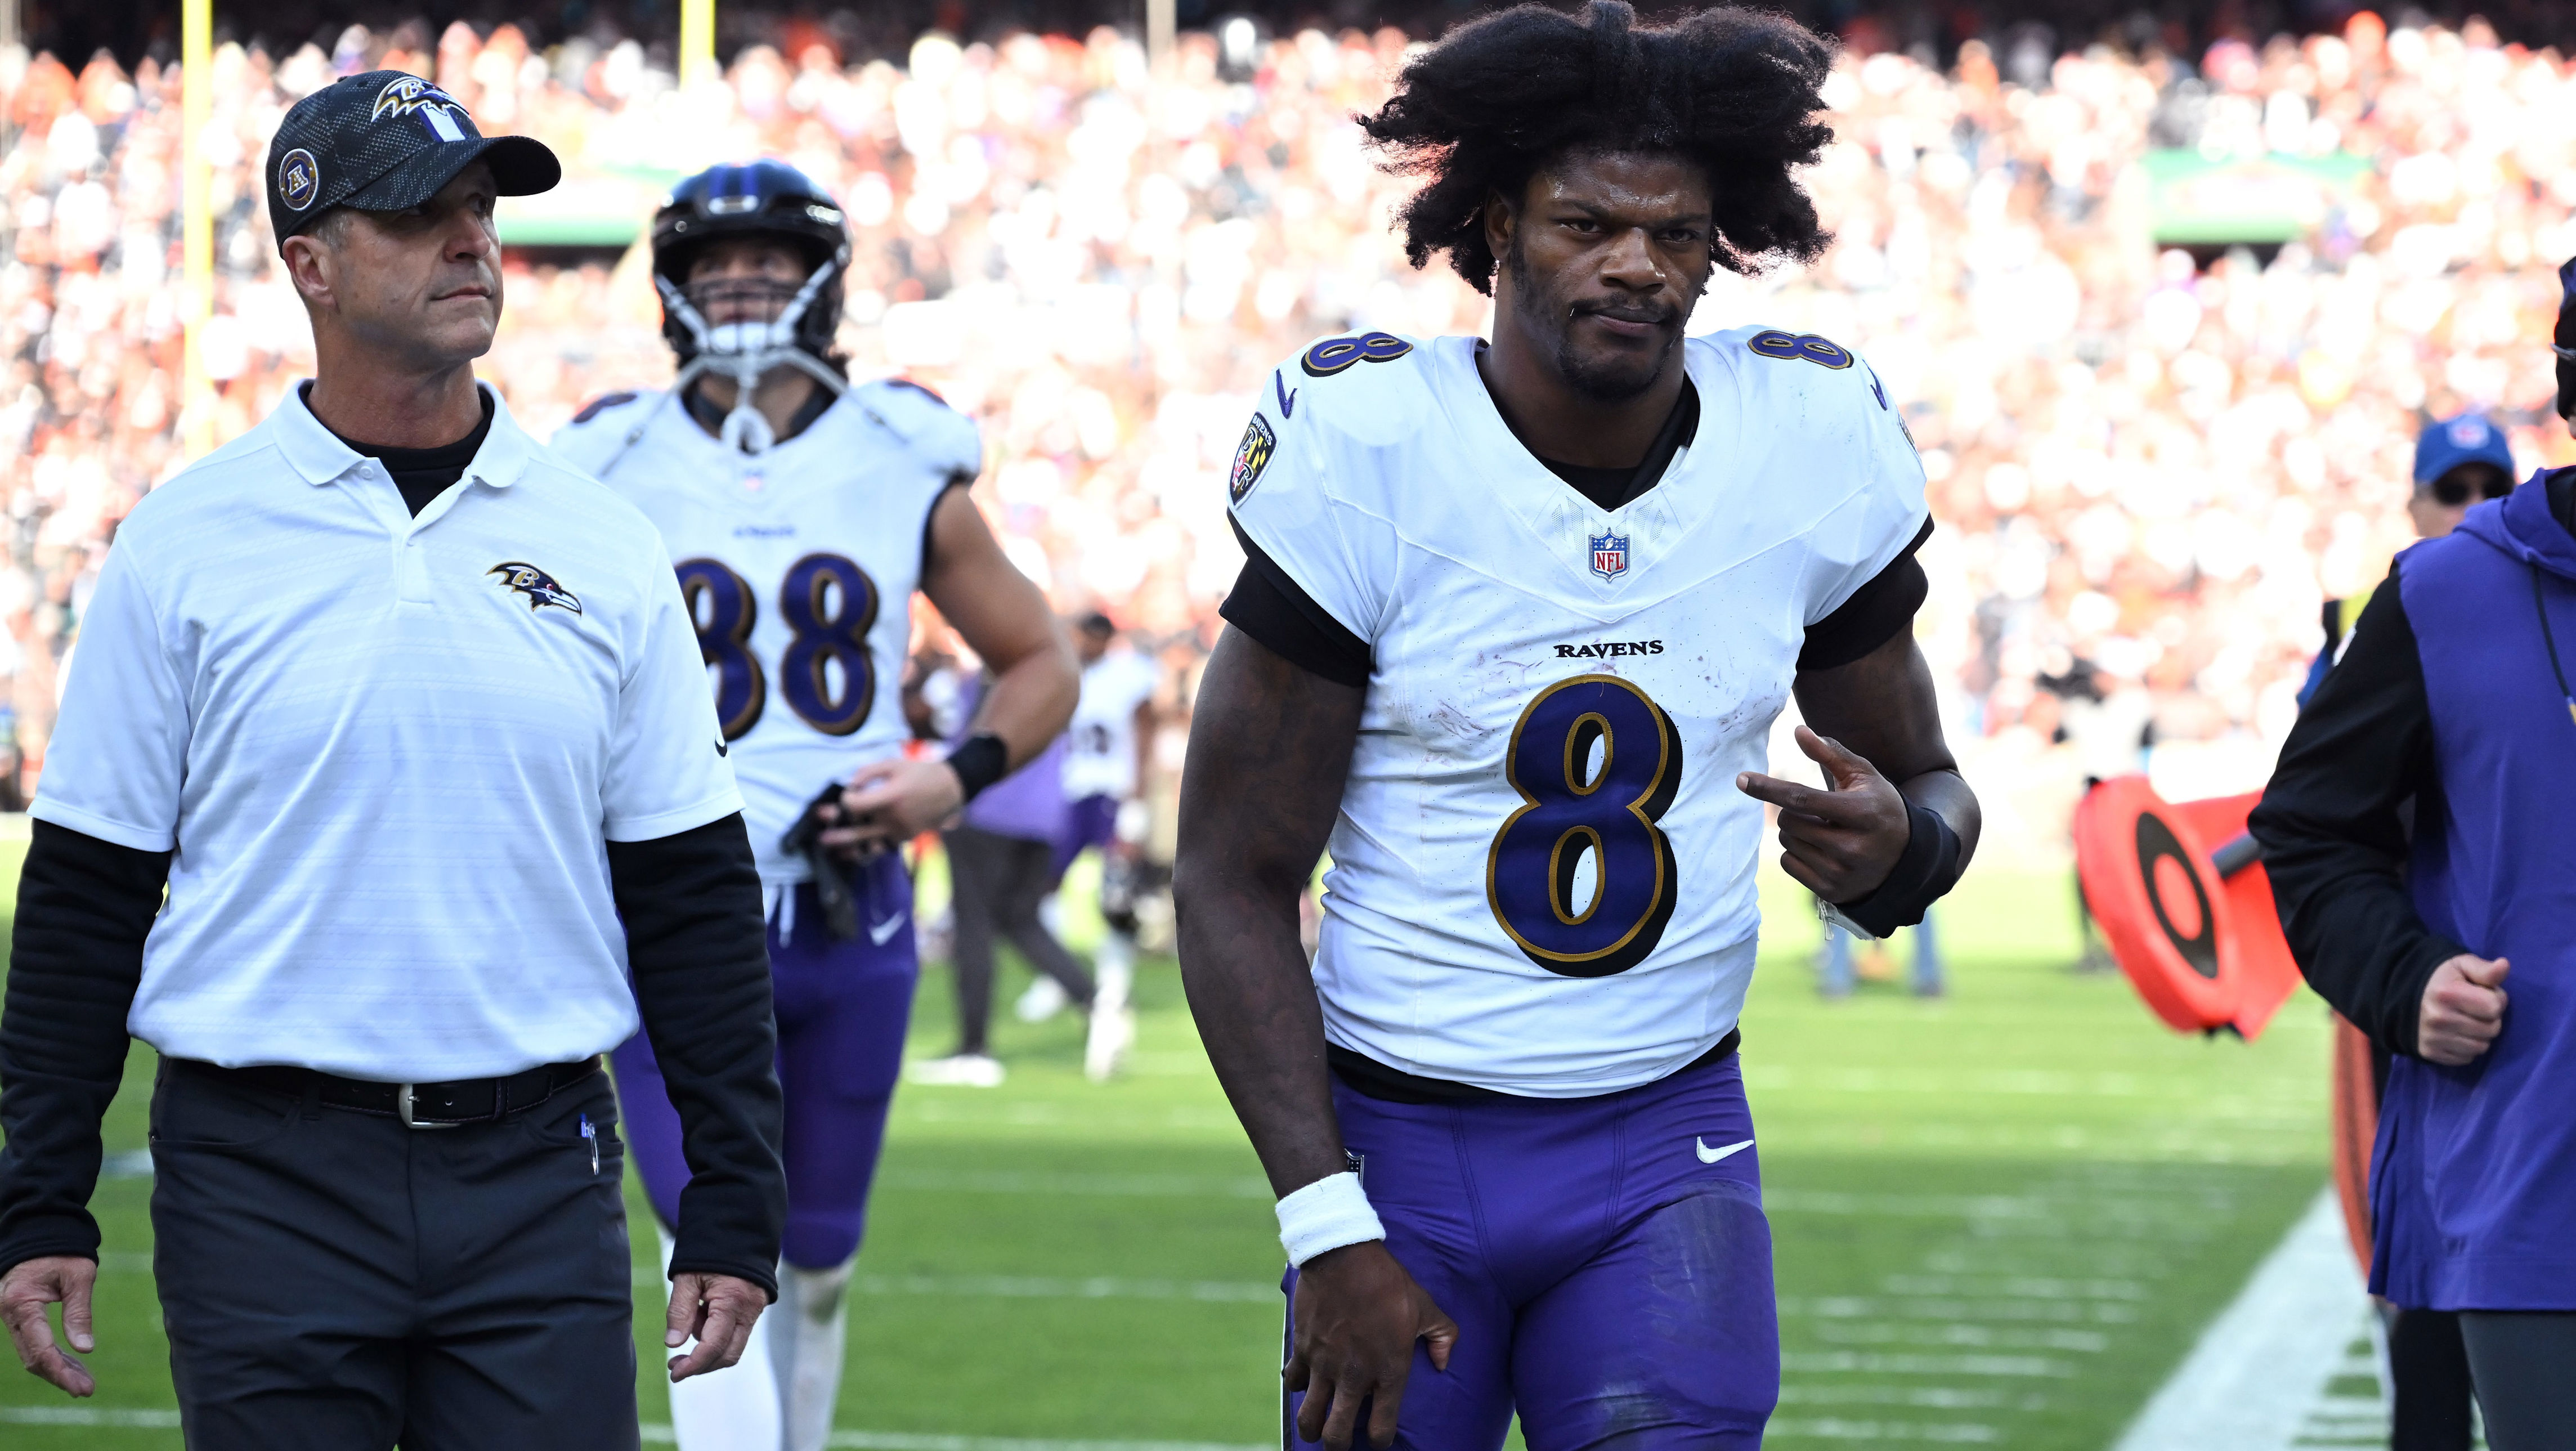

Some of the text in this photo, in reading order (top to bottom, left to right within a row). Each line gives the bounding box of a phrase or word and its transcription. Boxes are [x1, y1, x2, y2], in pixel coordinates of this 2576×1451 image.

[388, 79, 425, 101] B
[287, 164, 309, 195] A
[1301, 332, 1414, 378] 8
[1747, 330, 1854, 369] 8
[1242, 427, 1258, 453] B
[507, 565, 539, 586] B
[1595, 552, 1624, 572] NFL
[673, 552, 879, 742] 88
[1553, 639, 1664, 660] RAVENS
[1486, 673, 1683, 978] 8
